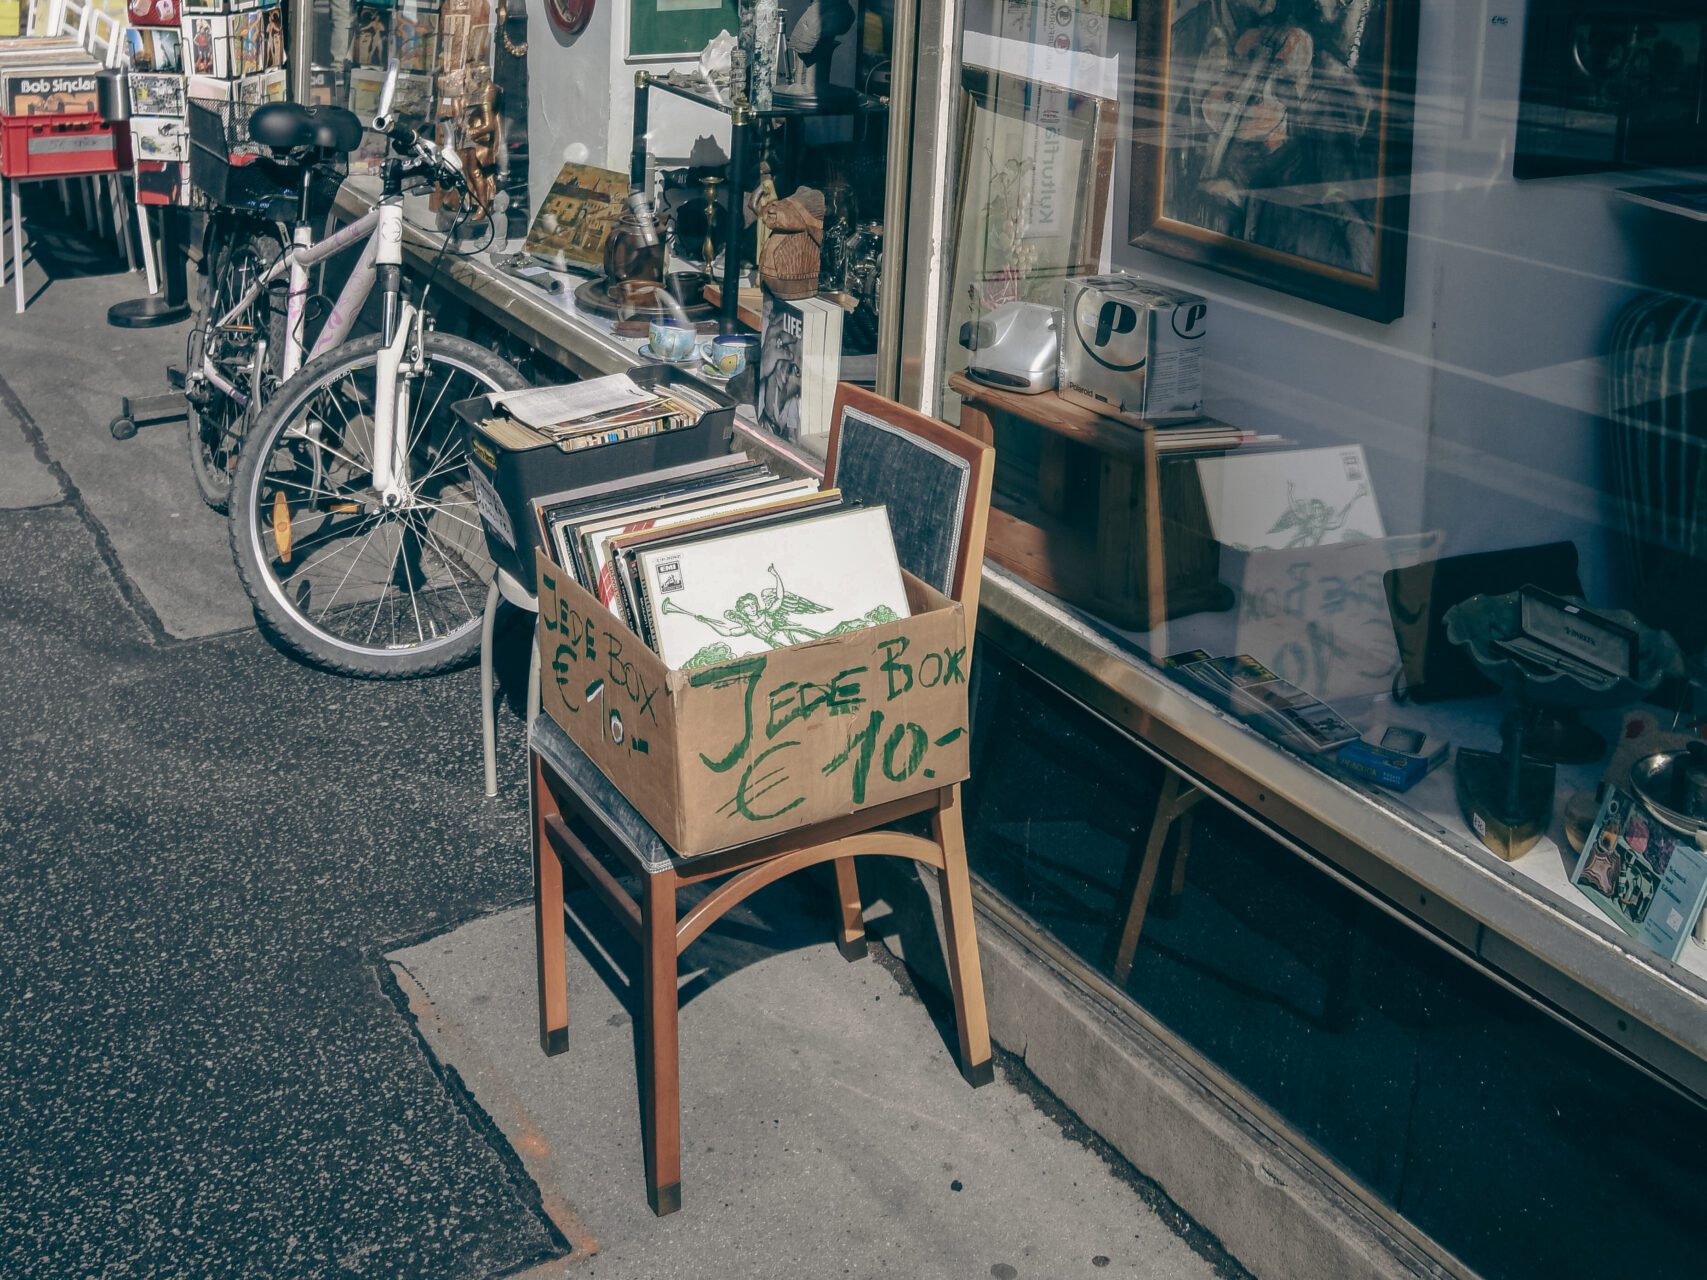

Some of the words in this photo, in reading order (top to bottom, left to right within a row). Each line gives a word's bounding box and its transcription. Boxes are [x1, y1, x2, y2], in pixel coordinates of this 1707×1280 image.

[21, 79, 51, 93] Bob
[52, 78, 97, 93] Sinclar
[783, 312, 802, 340] LIFE
[1069, 381, 1094, 398] Polaroid
[658, 563, 678, 573] EMI
[544, 574, 597, 662] JEDE
[603, 631, 659, 726] BOX
[552, 645, 579, 713] €
[688, 657, 869, 775] JEDE
[878, 636, 967, 701] BOX
[715, 740, 807, 822] €
